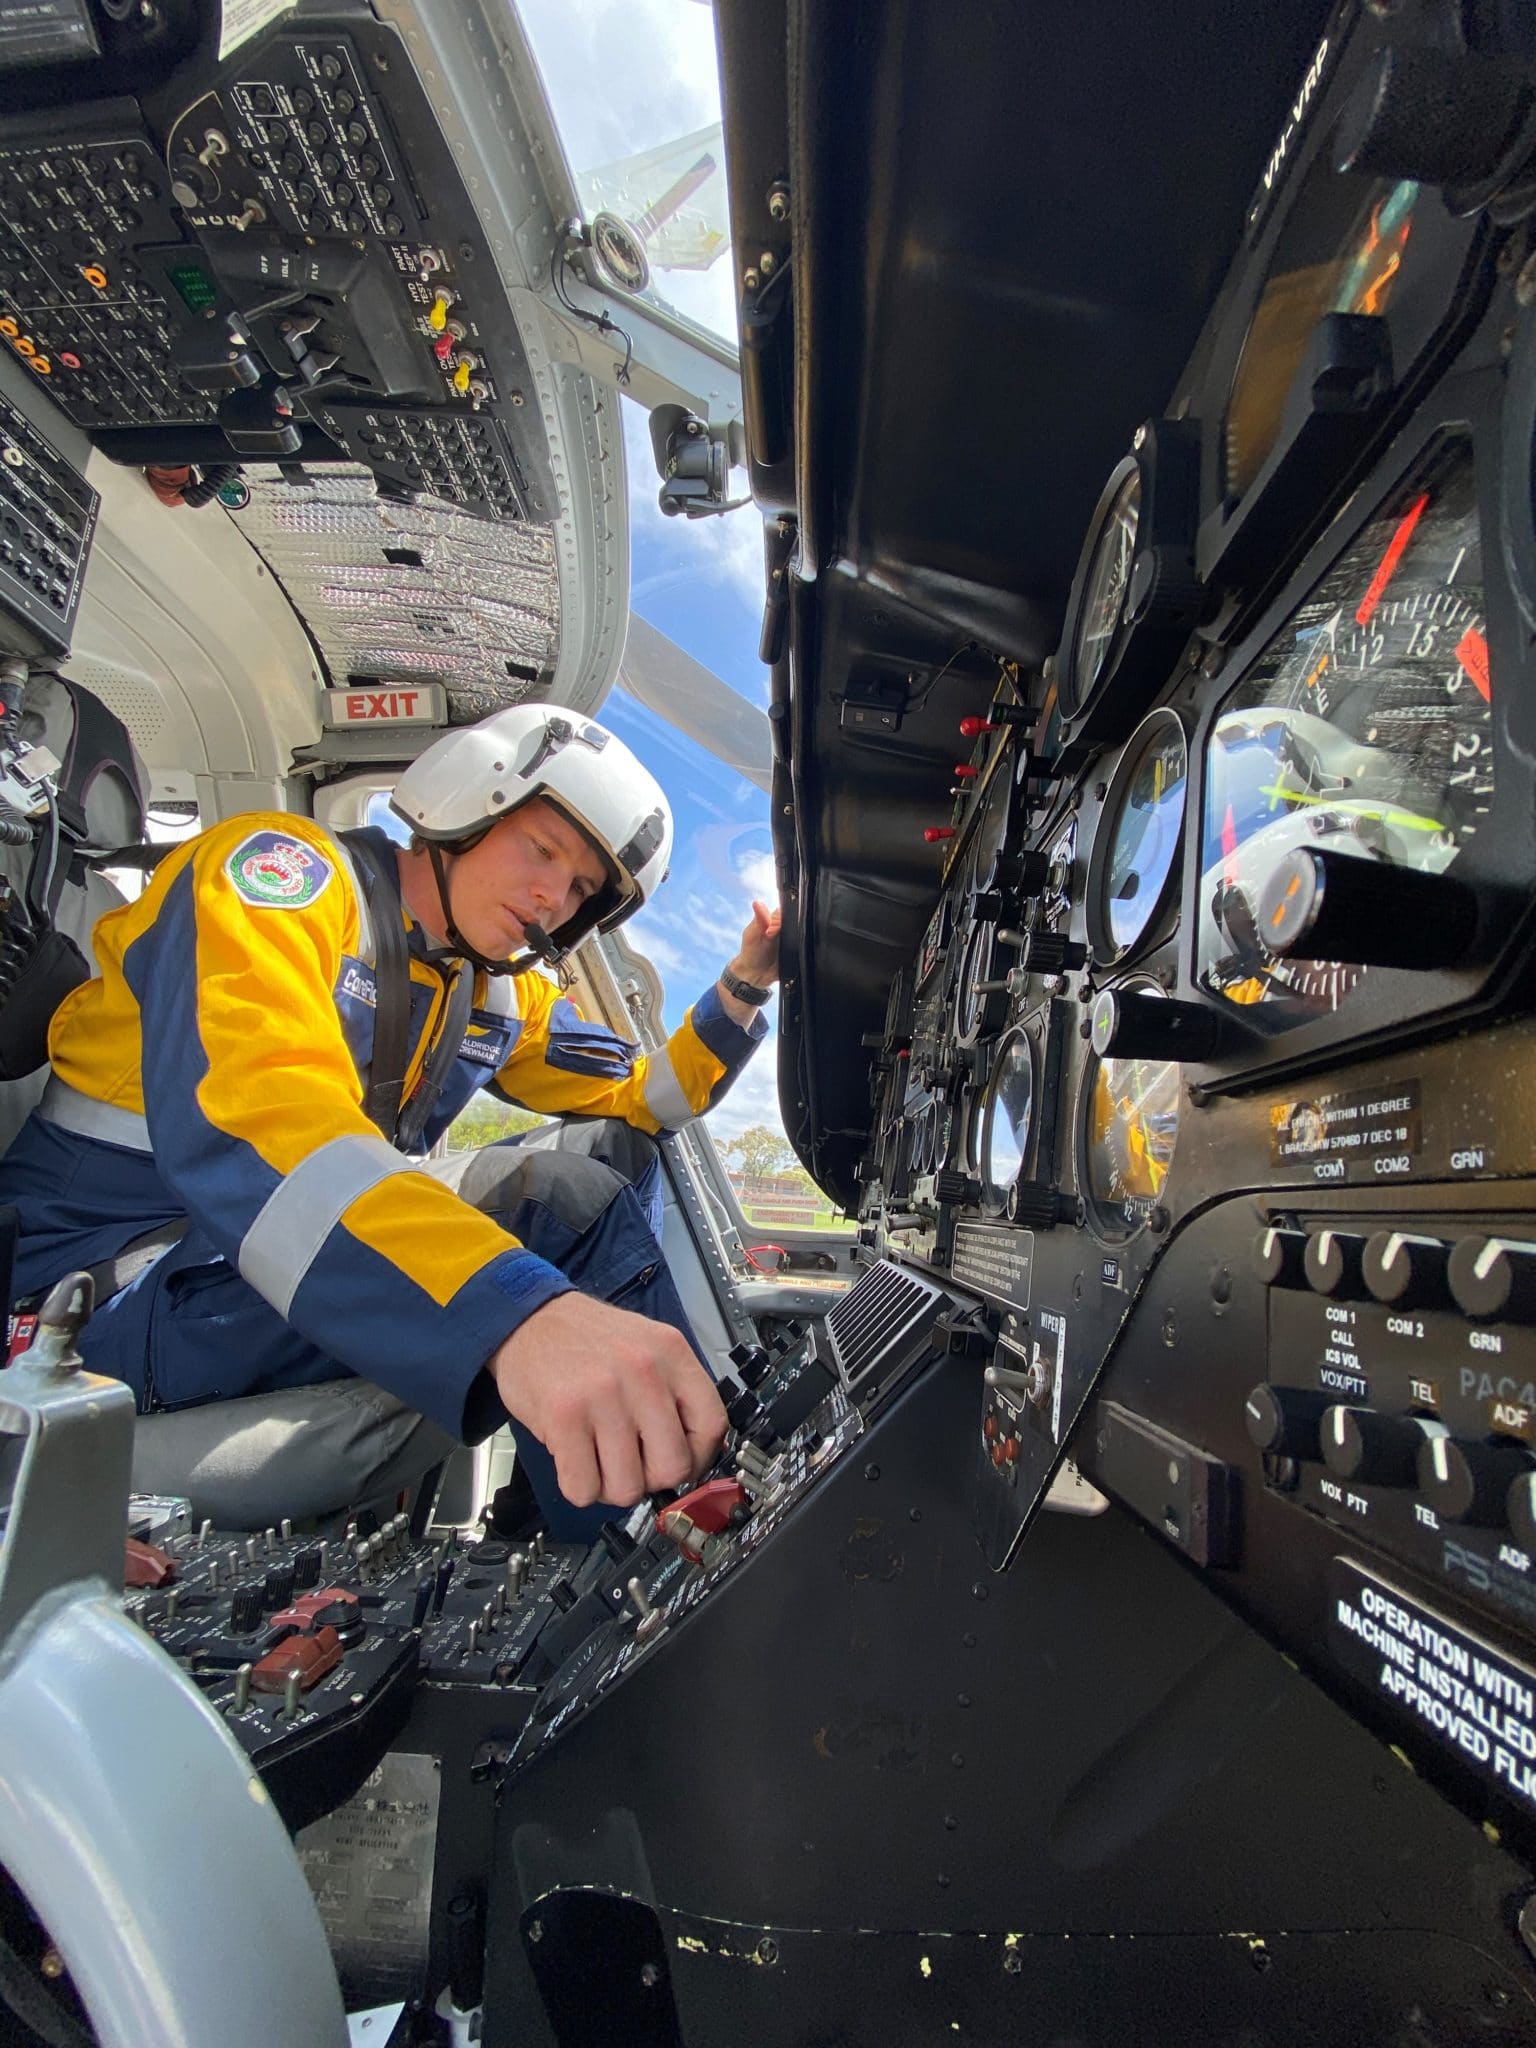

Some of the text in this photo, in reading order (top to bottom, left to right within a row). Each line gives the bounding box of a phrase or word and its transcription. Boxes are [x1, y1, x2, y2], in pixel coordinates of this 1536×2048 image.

[1406, 622, 1440, 657] 15
[1360, 634, 1384, 671] 12
[346, 692, 418, 719] EXIT
[462, 1038, 501, 1056] ALDRIDGE
[1326, 1107, 1357, 1123] WITHIN
[1367, 1097, 1411, 1116] DEGREE
[1371, 1129, 1392, 1144] DEC
[1374, 1157, 1410, 1174] COM2
[1450, 1150, 1485, 1170] GRN
[1103, 1263, 1116, 1277] ADF
[1040, 1311, 1059, 1334] WIPER
[1326, 1306, 1356, 1324] COM 1
[1331, 1330, 1355, 1347] CALL
[1387, 1317, 1424, 1338] COM 2
[1469, 1331, 1502, 1352] GRN
[1325, 1348, 1362, 1370] ICS VOL
[1320, 1369, 1367, 1396] VOX/PTT
[1411, 1380, 1436, 1404] TEL
[1493, 1403, 1528, 1428] ADF
[1320, 1479, 1368, 1515] VOX PTT
[1414, 1504, 1440, 1530] TEL
[1499, 1543, 1531, 1572] ADF
[1360, 1587, 1534, 1719] OPERATION WITH
[1338, 1600, 1536, 1760] MACHINE INSTALLED
[1381, 1663, 1490, 1762] APPROVED
